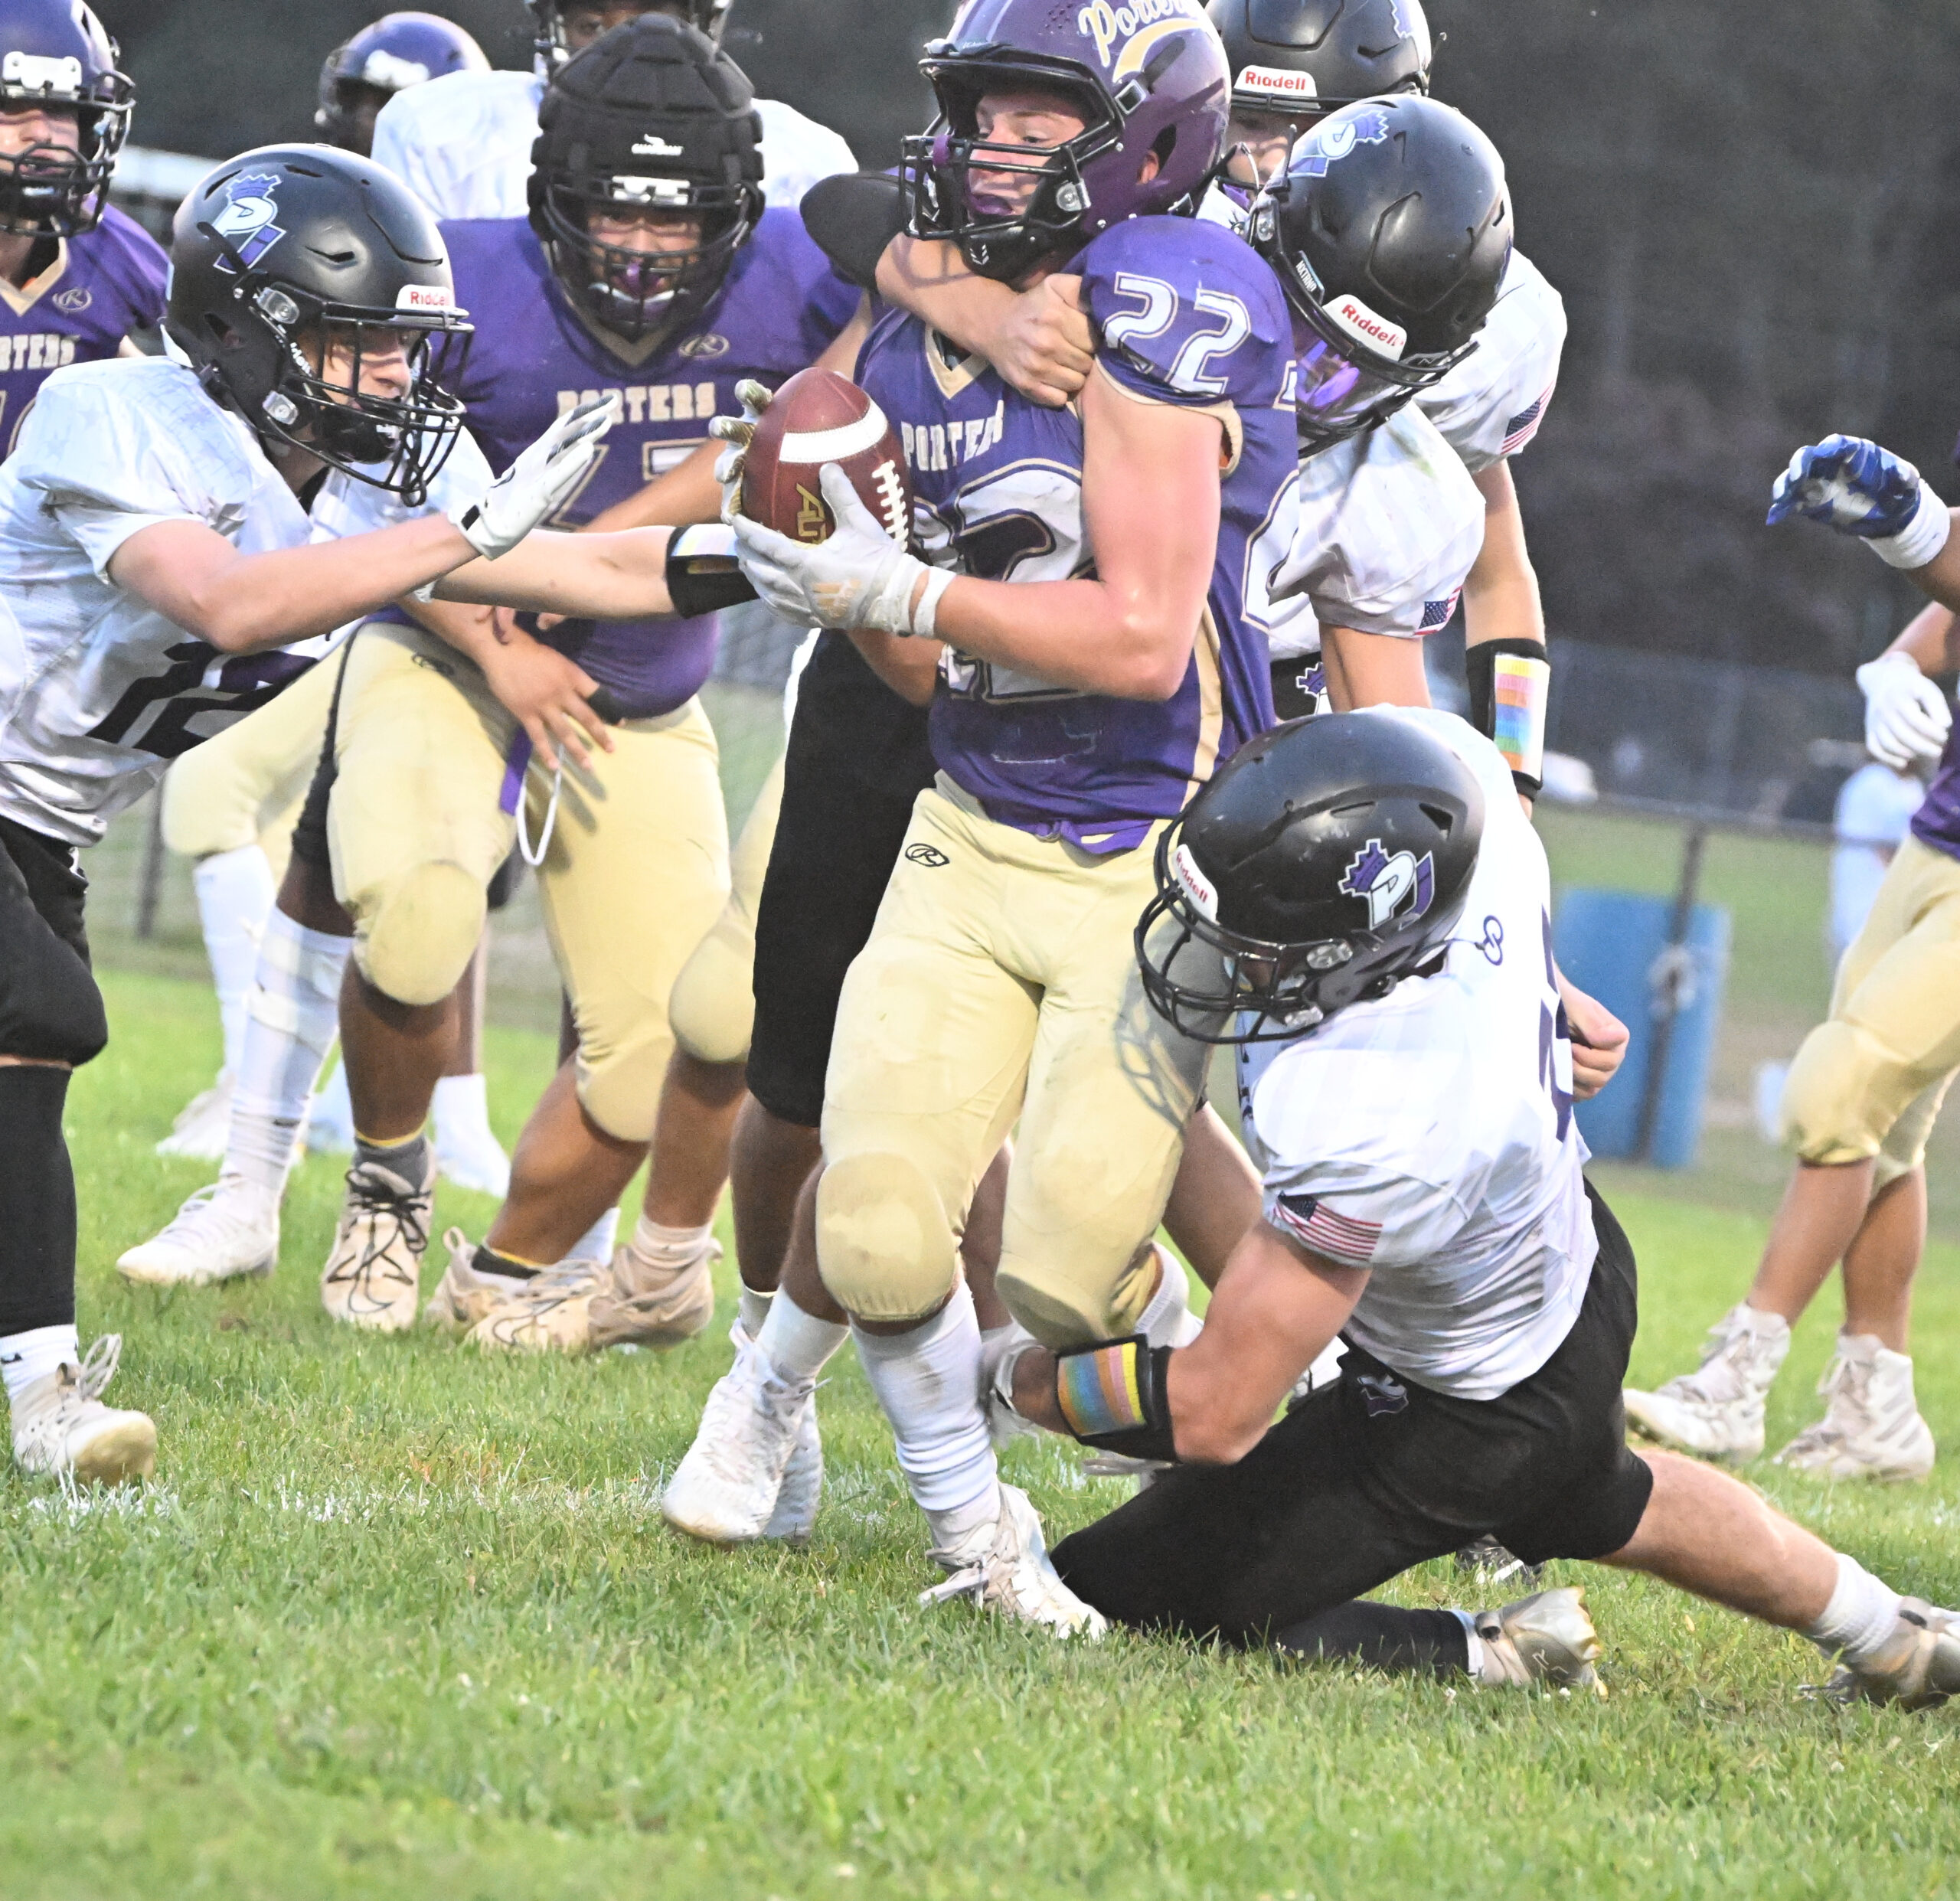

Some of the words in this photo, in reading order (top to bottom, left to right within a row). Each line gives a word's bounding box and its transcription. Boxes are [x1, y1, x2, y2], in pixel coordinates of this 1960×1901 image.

[1078, 0, 1205, 67] Porte
[1245, 70, 1306, 90] Riddell
[1295, 260, 1318, 292] NXTRND
[1101, 271, 1252, 397] 22
